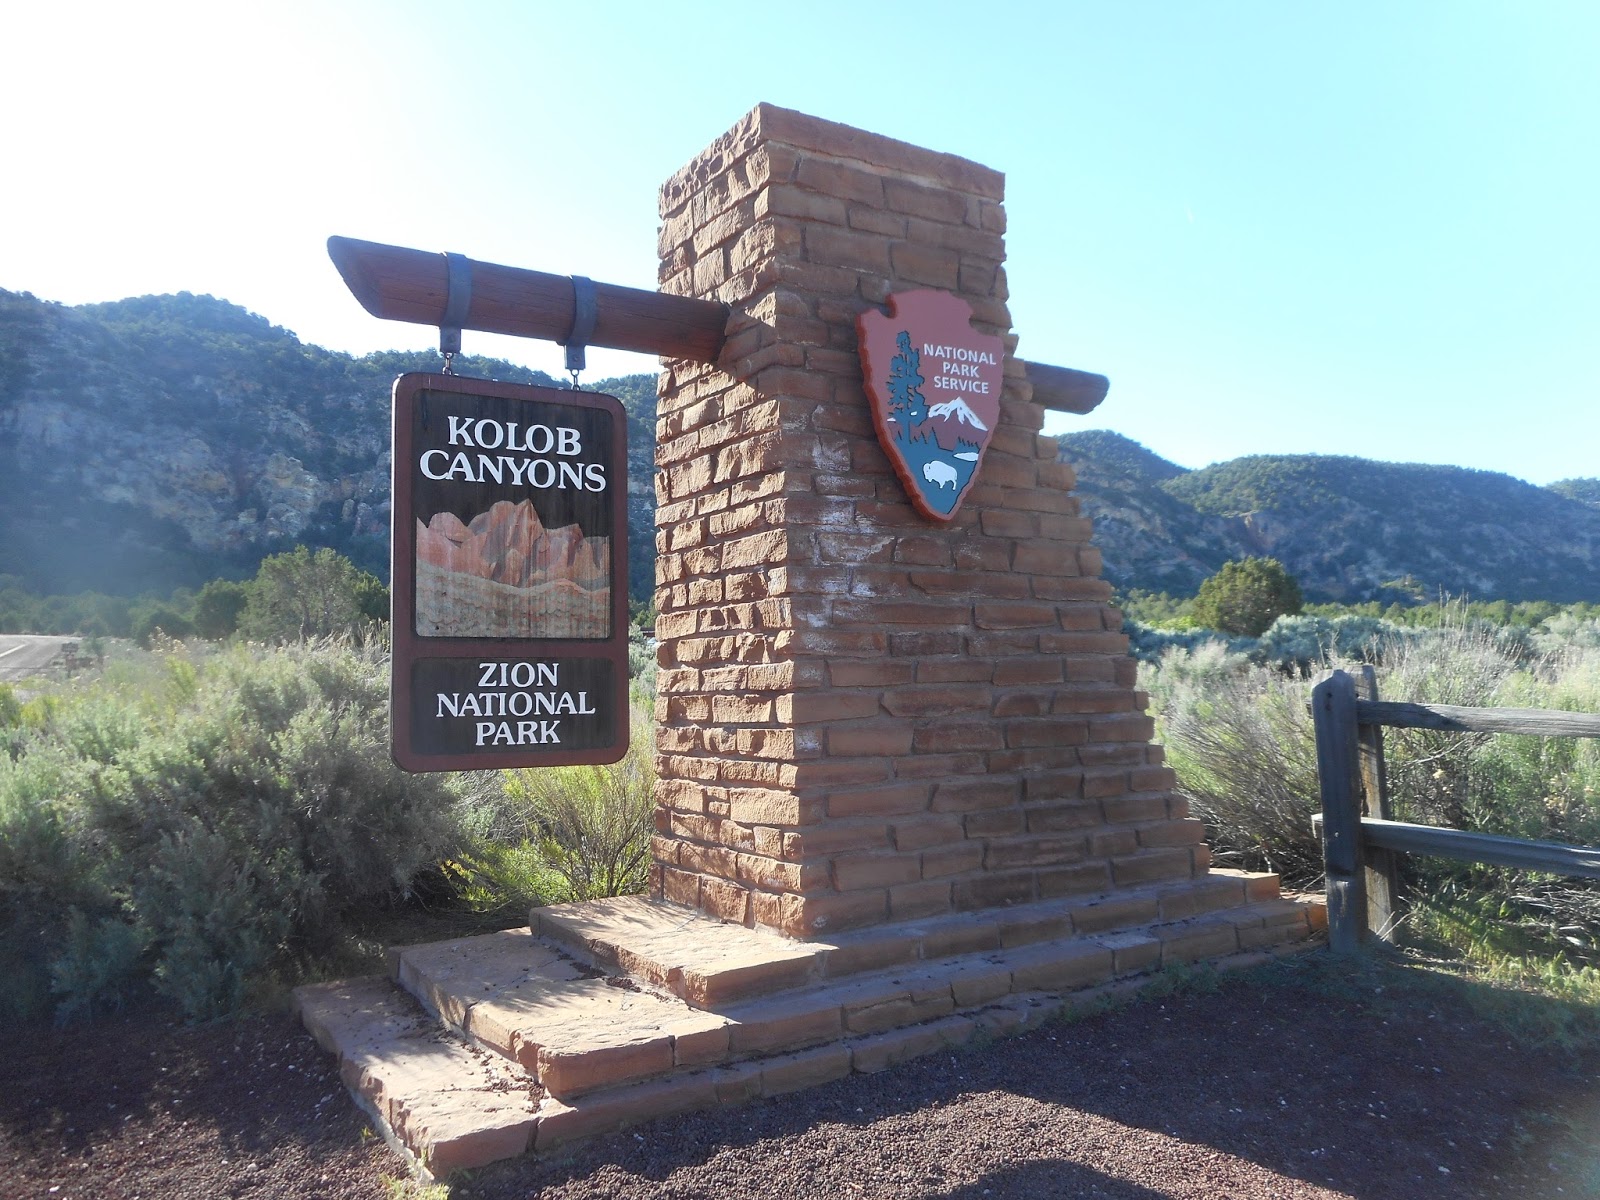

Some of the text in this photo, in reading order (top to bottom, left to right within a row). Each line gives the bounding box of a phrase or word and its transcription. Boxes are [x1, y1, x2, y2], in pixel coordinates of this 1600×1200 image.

[923, 343, 997, 366] NATIONAL
[942, 361, 980, 378] PARK
[933, 375, 990, 394] SERVICE
[447, 415, 582, 457] KOLOB
[419, 449, 607, 493] CANYONS
[477, 662, 559, 688] ZION
[436, 691, 596, 718] NATIONAL
[475, 720, 561, 746] PARK
